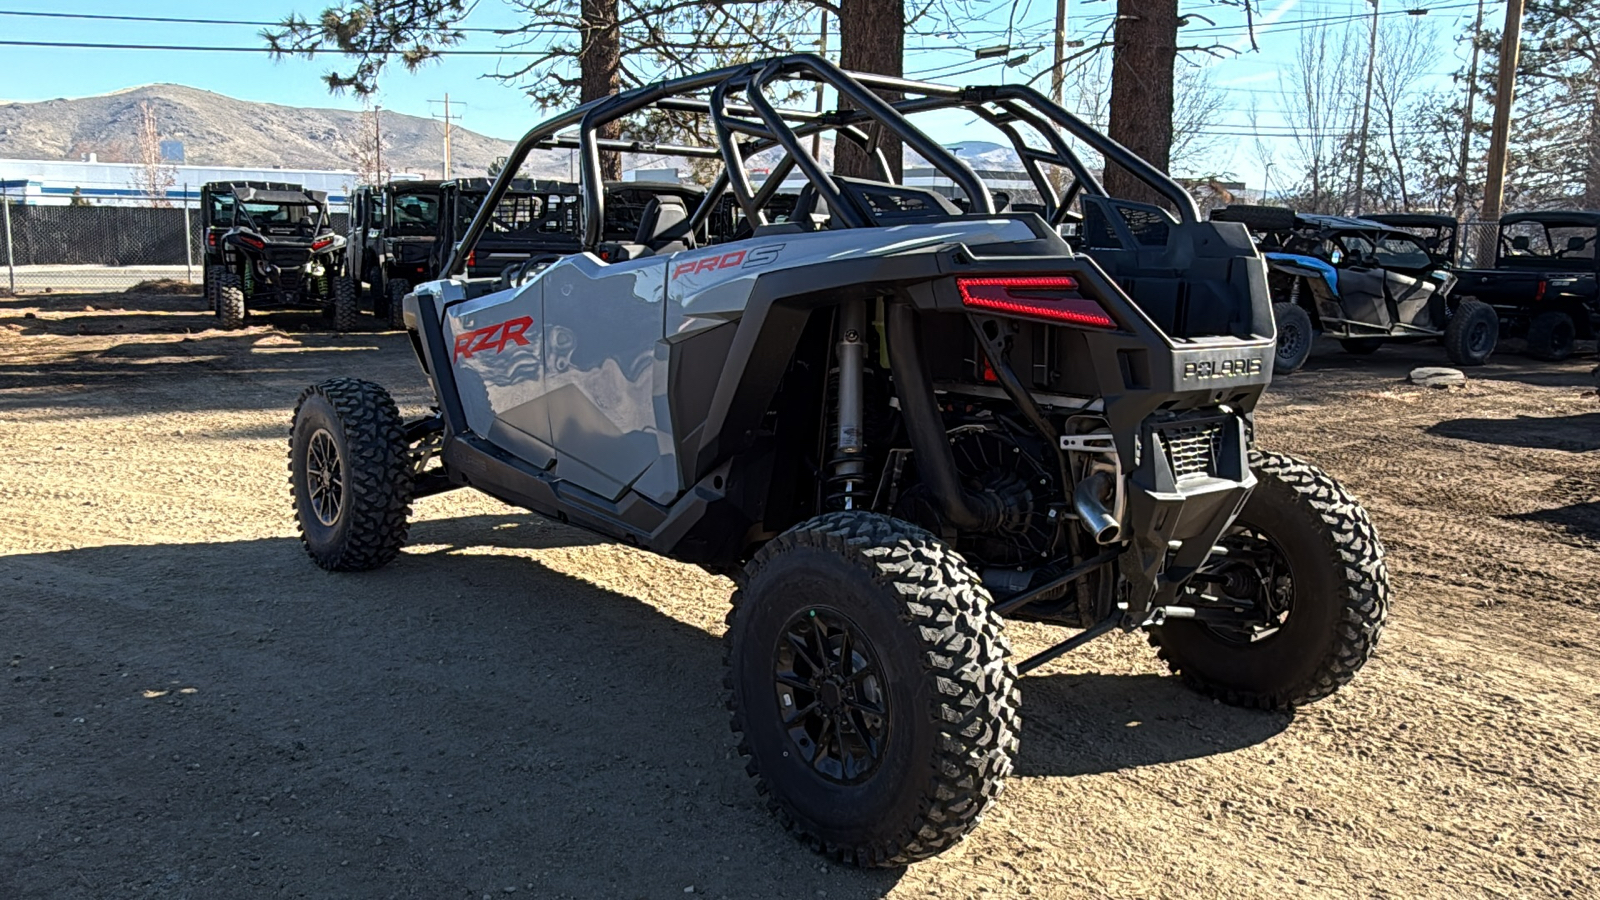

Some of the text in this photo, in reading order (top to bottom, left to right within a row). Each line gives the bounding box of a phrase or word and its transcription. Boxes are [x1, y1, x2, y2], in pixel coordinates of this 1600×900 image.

[672, 250, 747, 280] PRO
[453, 316, 534, 365] RZR
[1183, 357, 1262, 380] POLARIS
